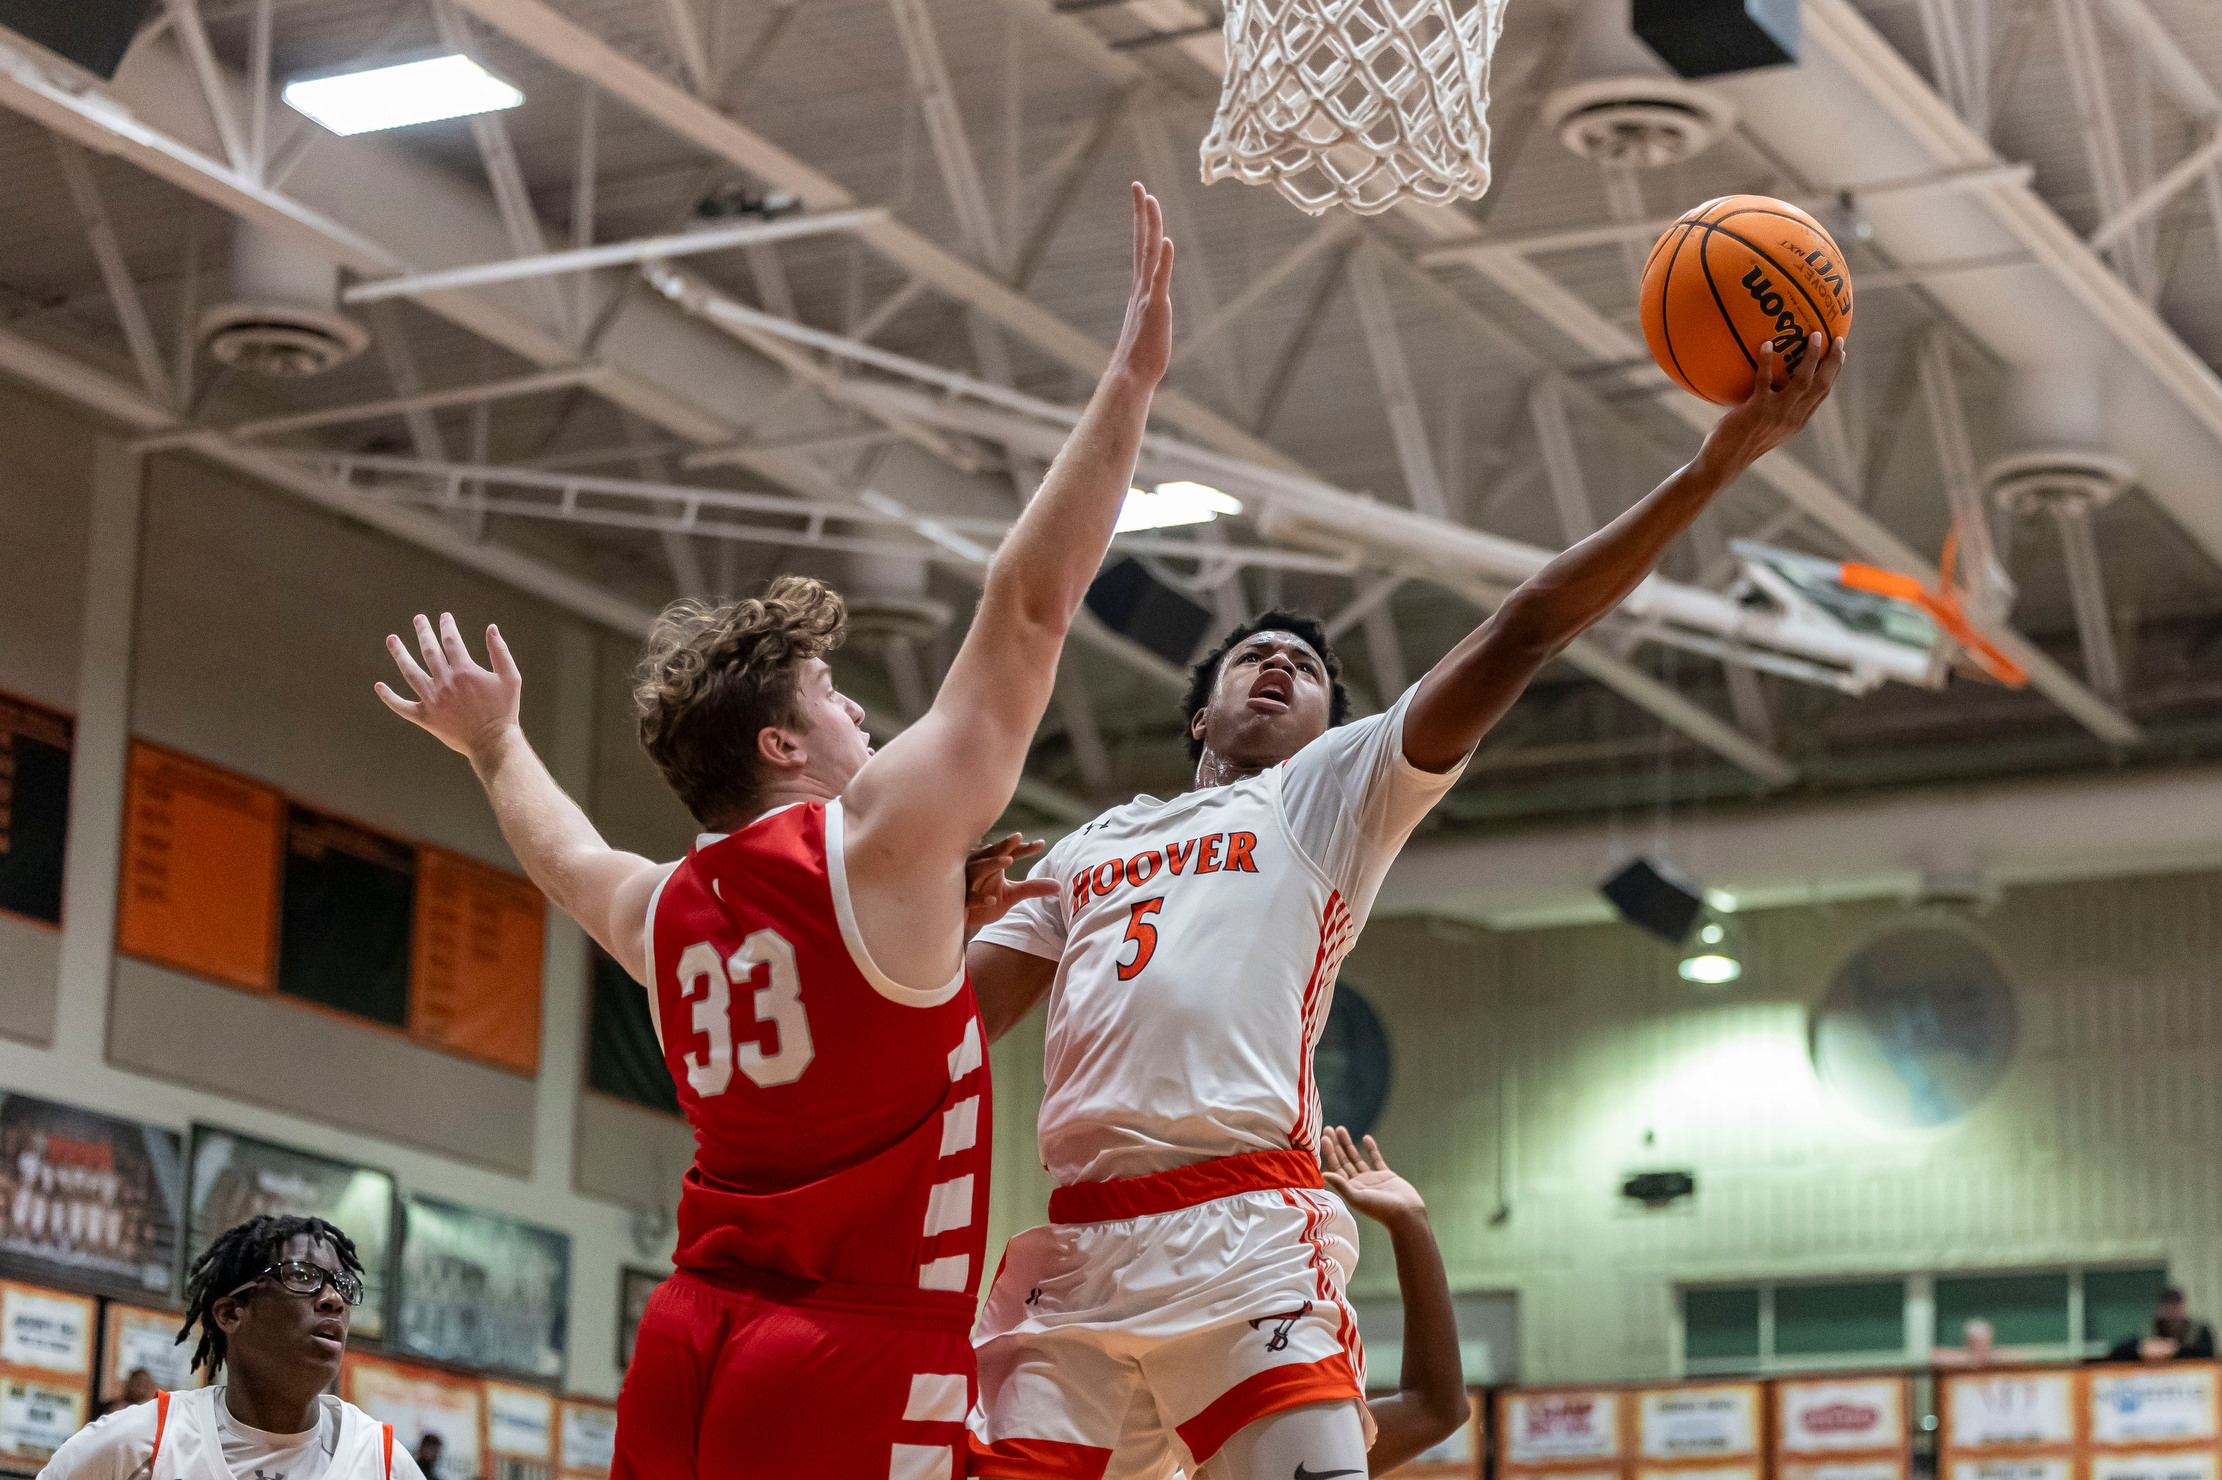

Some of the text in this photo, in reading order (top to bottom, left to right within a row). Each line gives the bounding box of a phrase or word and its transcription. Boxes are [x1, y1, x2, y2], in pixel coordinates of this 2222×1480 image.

[1780, 240, 1852, 316] EVO NXT
[1072, 832, 1260, 918] HOOVER
[1116, 897, 1165, 982] 5
[676, 928, 816, 1099] 33
